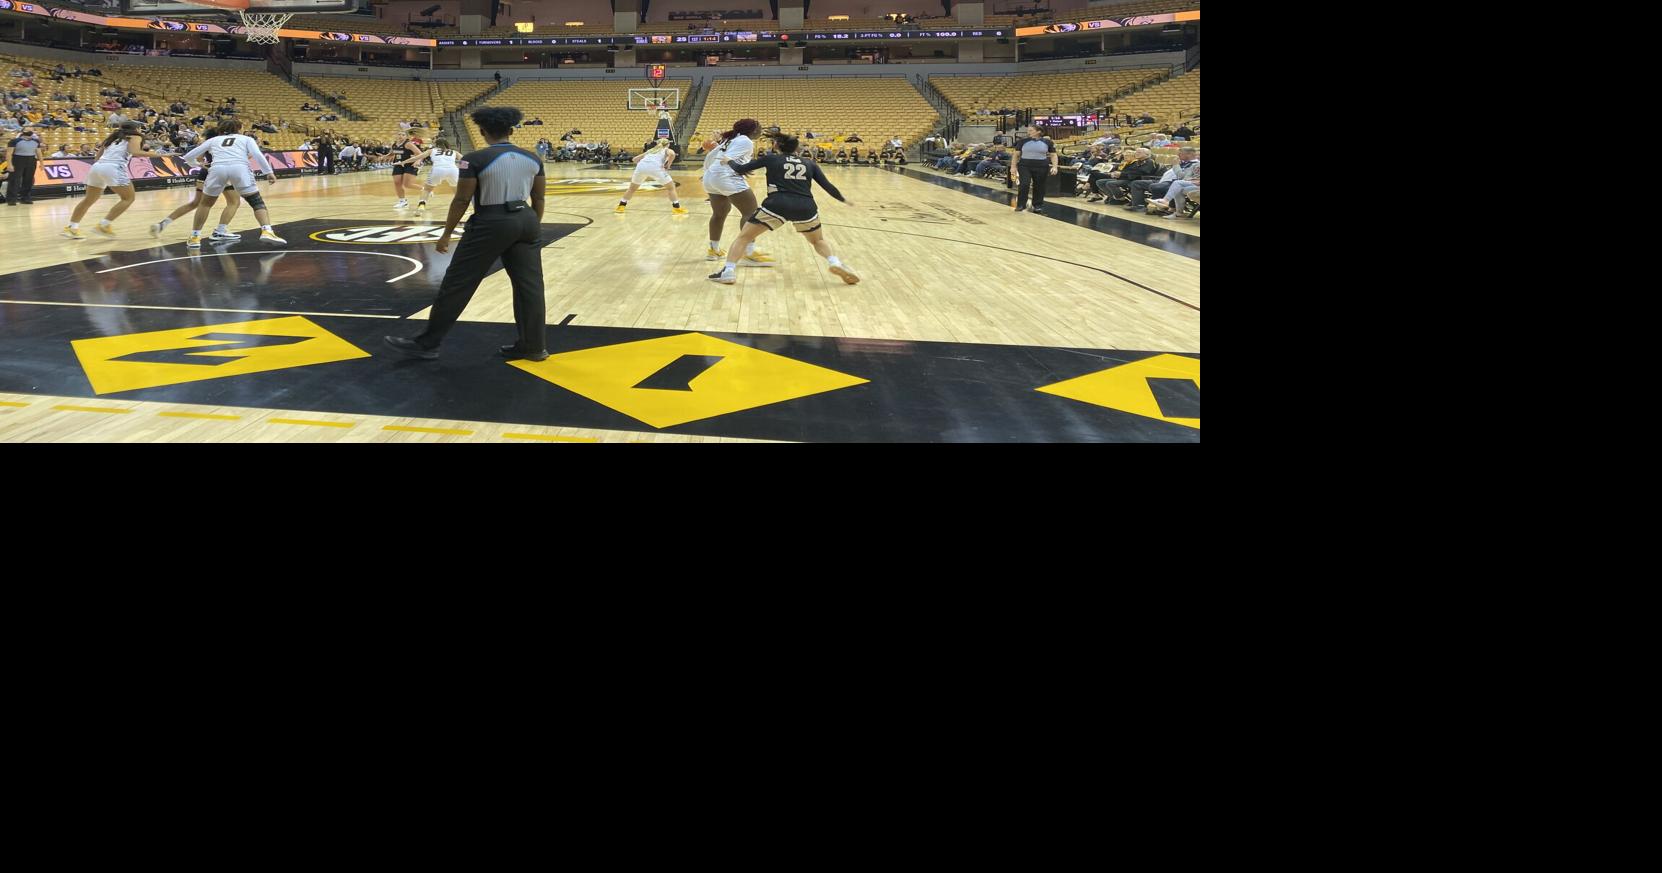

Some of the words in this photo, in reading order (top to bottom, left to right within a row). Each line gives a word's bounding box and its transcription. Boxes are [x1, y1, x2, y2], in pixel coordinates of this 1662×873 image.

[221, 137, 236, 147] 0
[44, 165, 72, 178] VS
[783, 163, 807, 180] 22
